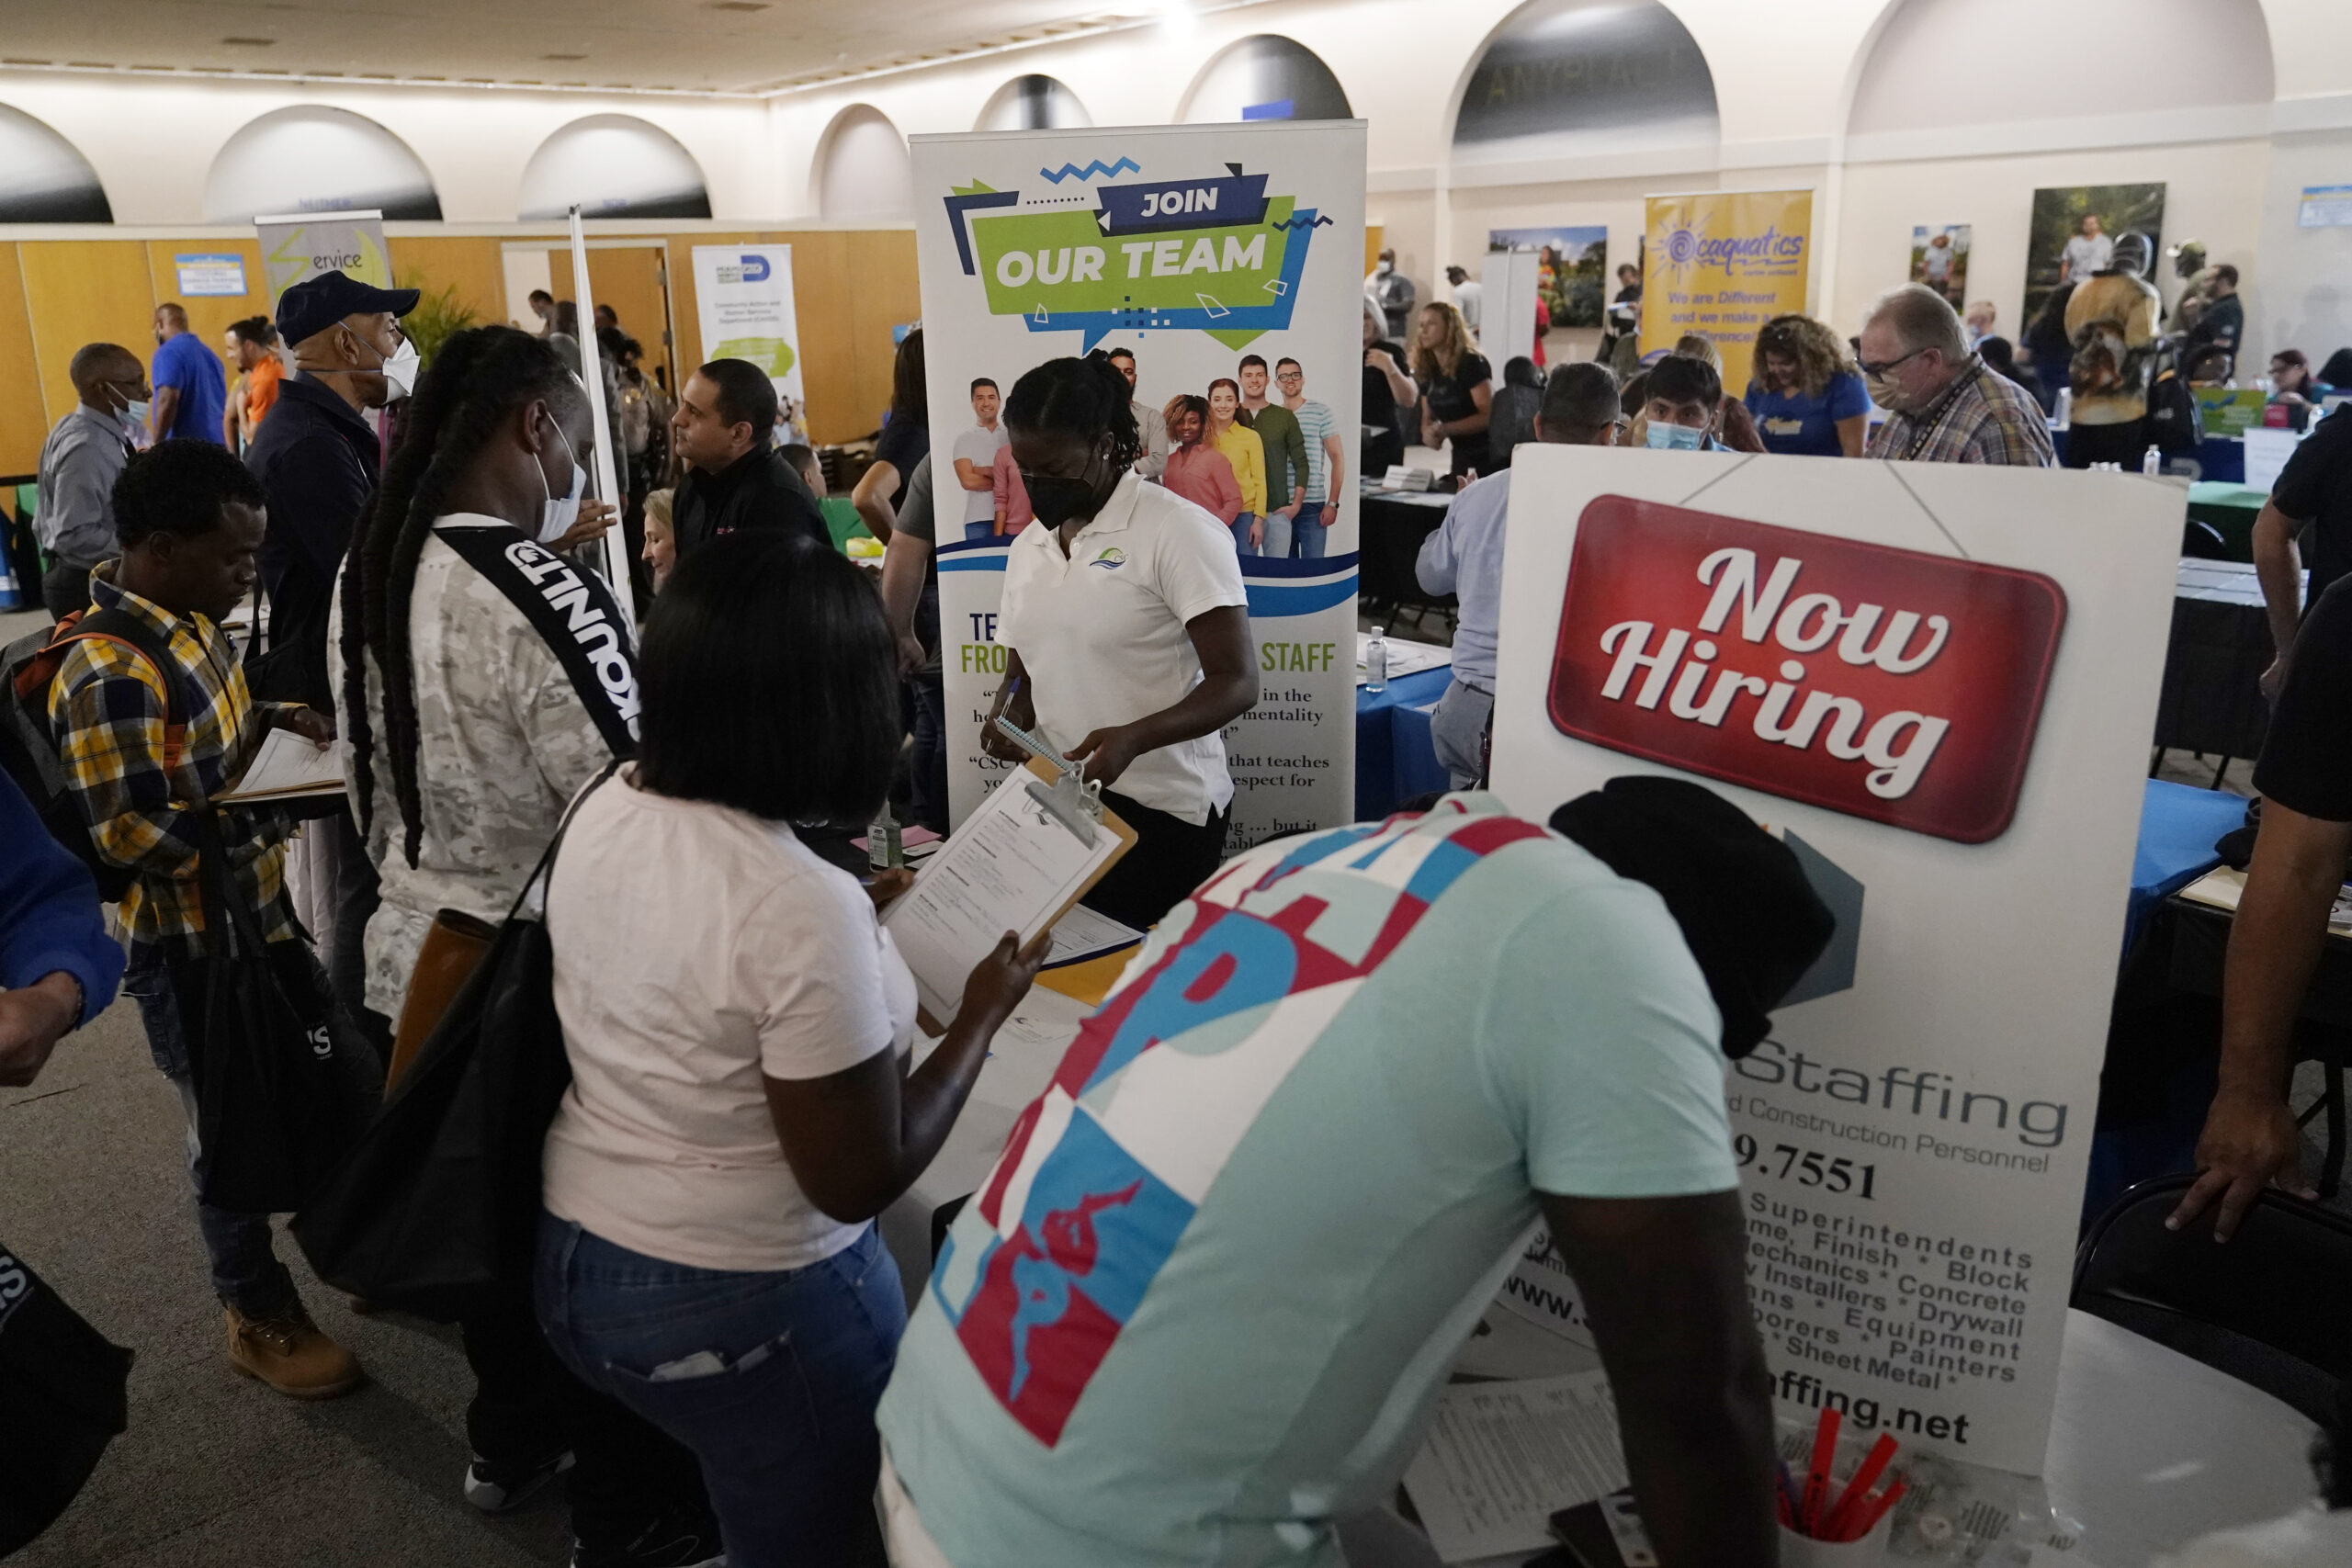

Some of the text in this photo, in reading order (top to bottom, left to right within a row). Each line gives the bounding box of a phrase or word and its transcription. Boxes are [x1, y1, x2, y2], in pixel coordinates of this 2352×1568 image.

[1140, 186, 1219, 219] JOIN
[996, 233, 1267, 288] OUR TEAM
[1668, 291, 1776, 304] We are Different
[1671, 311, 1695, 323] and
[1699, 313, 1718, 323] we
[1722, 310, 1758, 323] make
[969, 613, 998, 641] TE
[1696, 547, 1950, 675] Now
[961, 641, 1336, 674] FRO STAFF
[1263, 688, 1312, 702] in the
[1599, 620, 1951, 800] Hiring
[1229, 753, 1262, 767] that
[1268, 754, 1329, 768] teaches
[1232, 774, 1285, 791] espect
[1290, 773, 1316, 787] for
[1273, 818, 1299, 831] but
[1306, 819, 1317, 831] it
[1734, 1038, 2067, 1148] Staffing
[1748, 1097, 1907, 1150] Construction
[1916, 1133, 2050, 1173] Personnel
[1733, 1133, 1877, 1201] 9.7551
[1750, 1191, 2032, 1269] Superintendents
[1814, 1231, 1898, 1269] Finish
[1948, 1260, 2029, 1292] Block
[1765, 1262, 2024, 1338] Installers Drywall
[1897, 1274, 2026, 1315] Concrete
[1844, 1306, 2020, 1361] Equipment
[1786, 1336, 1940, 1390] Sheet Metal
[1889, 1339, 2016, 1382] Painters
